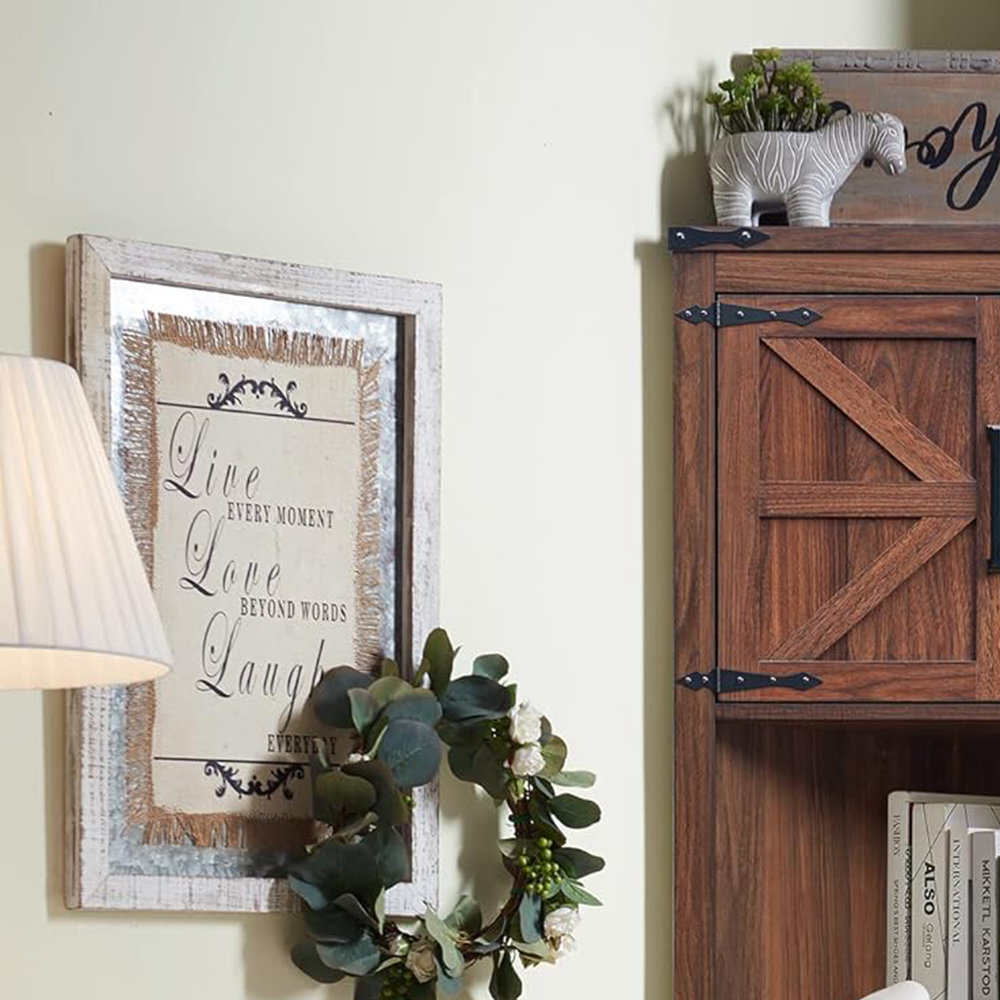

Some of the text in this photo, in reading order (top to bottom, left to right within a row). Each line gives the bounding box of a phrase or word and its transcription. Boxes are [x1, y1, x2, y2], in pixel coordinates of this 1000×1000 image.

[163, 411, 260, 499] Live
[227, 501, 334, 529] EVERY MOMENT
[179, 509, 281, 597] Love
[240, 597, 347, 623] BEYOND WORDS
[267, 734, 338, 755] EVERYDY
[923, 862, 936, 916] ALSO
[952, 838, 961, 947] INTERNATIONAL
[981, 860, 991, 996] MIKKETL KARSTOD
